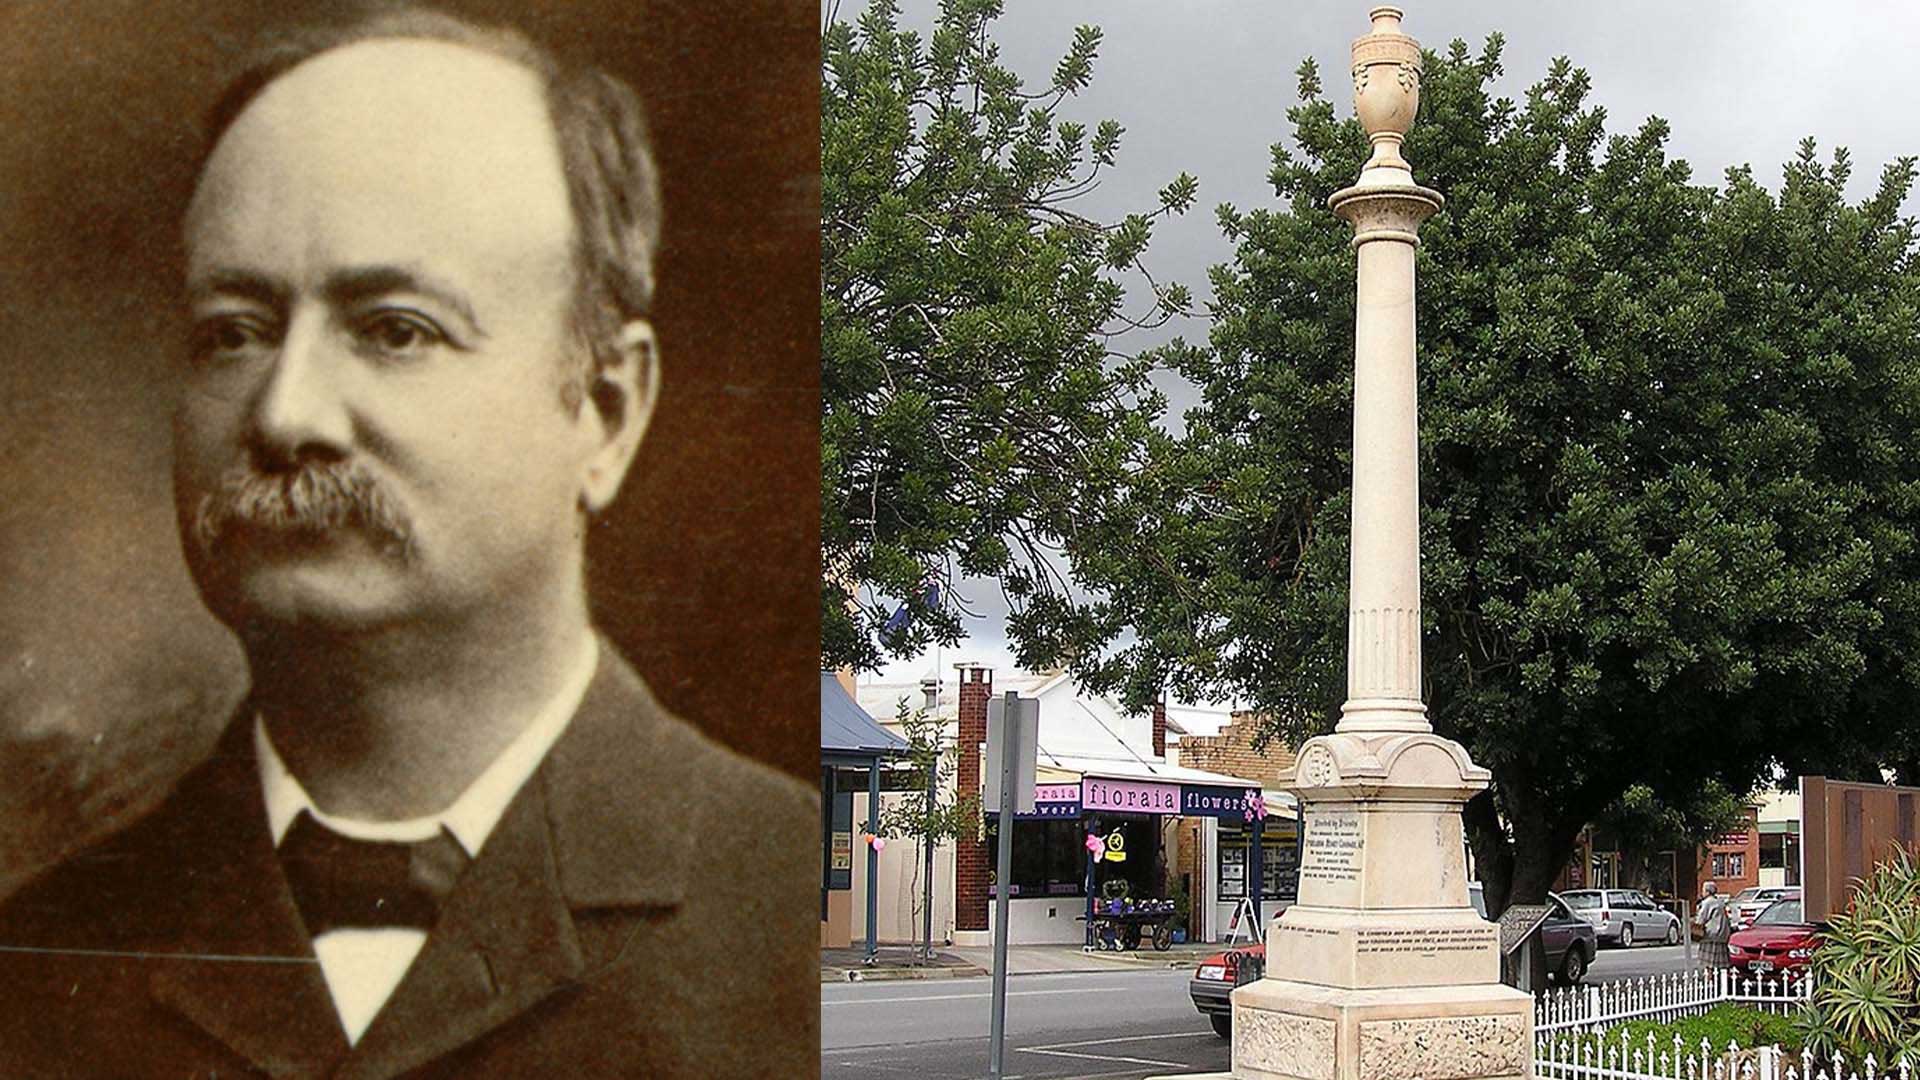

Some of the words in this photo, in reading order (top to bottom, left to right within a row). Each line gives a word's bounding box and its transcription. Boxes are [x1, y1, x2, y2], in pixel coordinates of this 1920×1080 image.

[1034, 789, 1076, 799] oraia
[1090, 784, 1174, 809] fioraia
[1186, 792, 1247, 811] flowers
